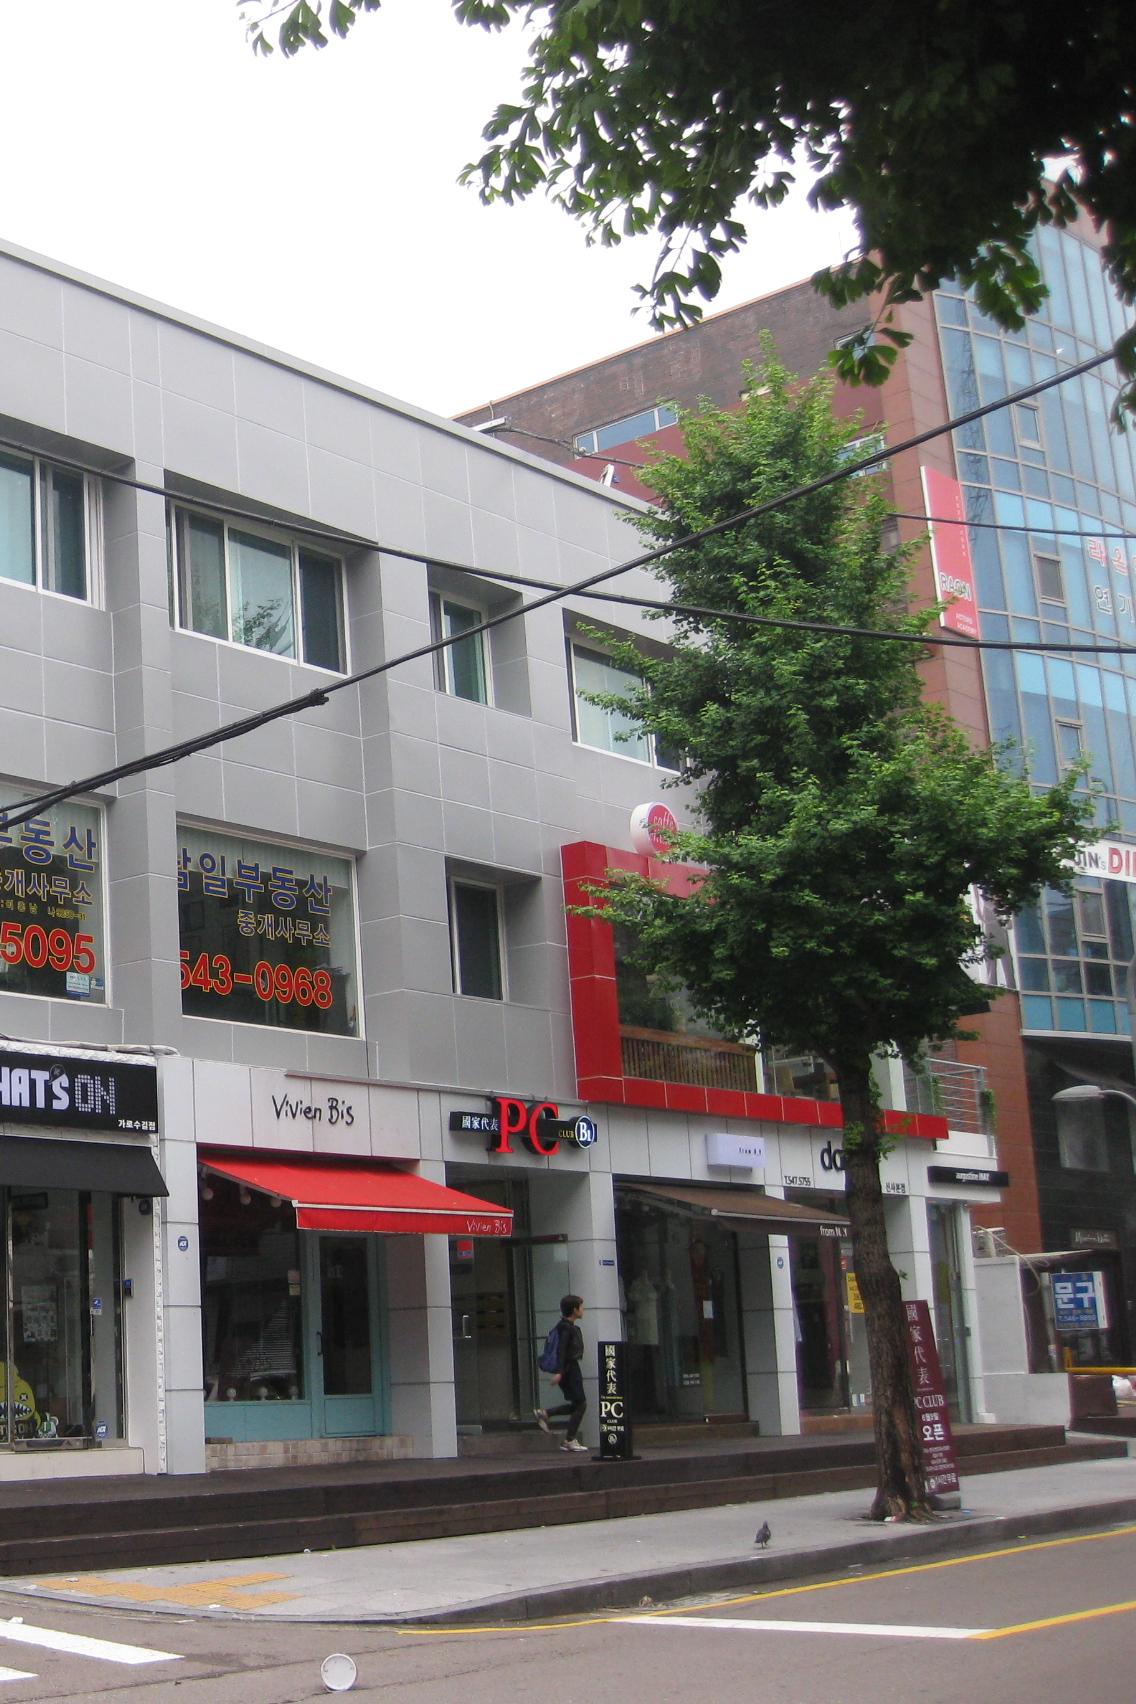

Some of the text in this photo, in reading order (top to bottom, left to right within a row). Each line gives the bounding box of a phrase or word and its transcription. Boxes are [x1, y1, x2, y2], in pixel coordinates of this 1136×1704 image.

[1108, 847, 1136, 877] DI
[237, 909, 332, 948] 중개사무소
[180, 950, 333, 1010] 543-0968
[74, 1073, 117, 1115] ON
[271, 1094, 355, 1127] Vivien Bis
[461, 1114, 499, 1132] 國家代表
[117, 1118, 157, 1132] 가로수길점
[495, 1097, 560, 1156] PC
[558, 1130, 575, 1139] CLUB
[466, 1219, 507, 1234] Vivien Bis
[820, 1225, 835, 1236] from
[1055, 1282, 1095, 1309] 문구
[905, 1304, 930, 1385] 國家代表
[605, 1345, 618, 1395] 國家代表
[600, 1401, 624, 1418] PC
[923, 1394, 944, 1408] CLUB
[922, 1423, 945, 1441] 오픈
